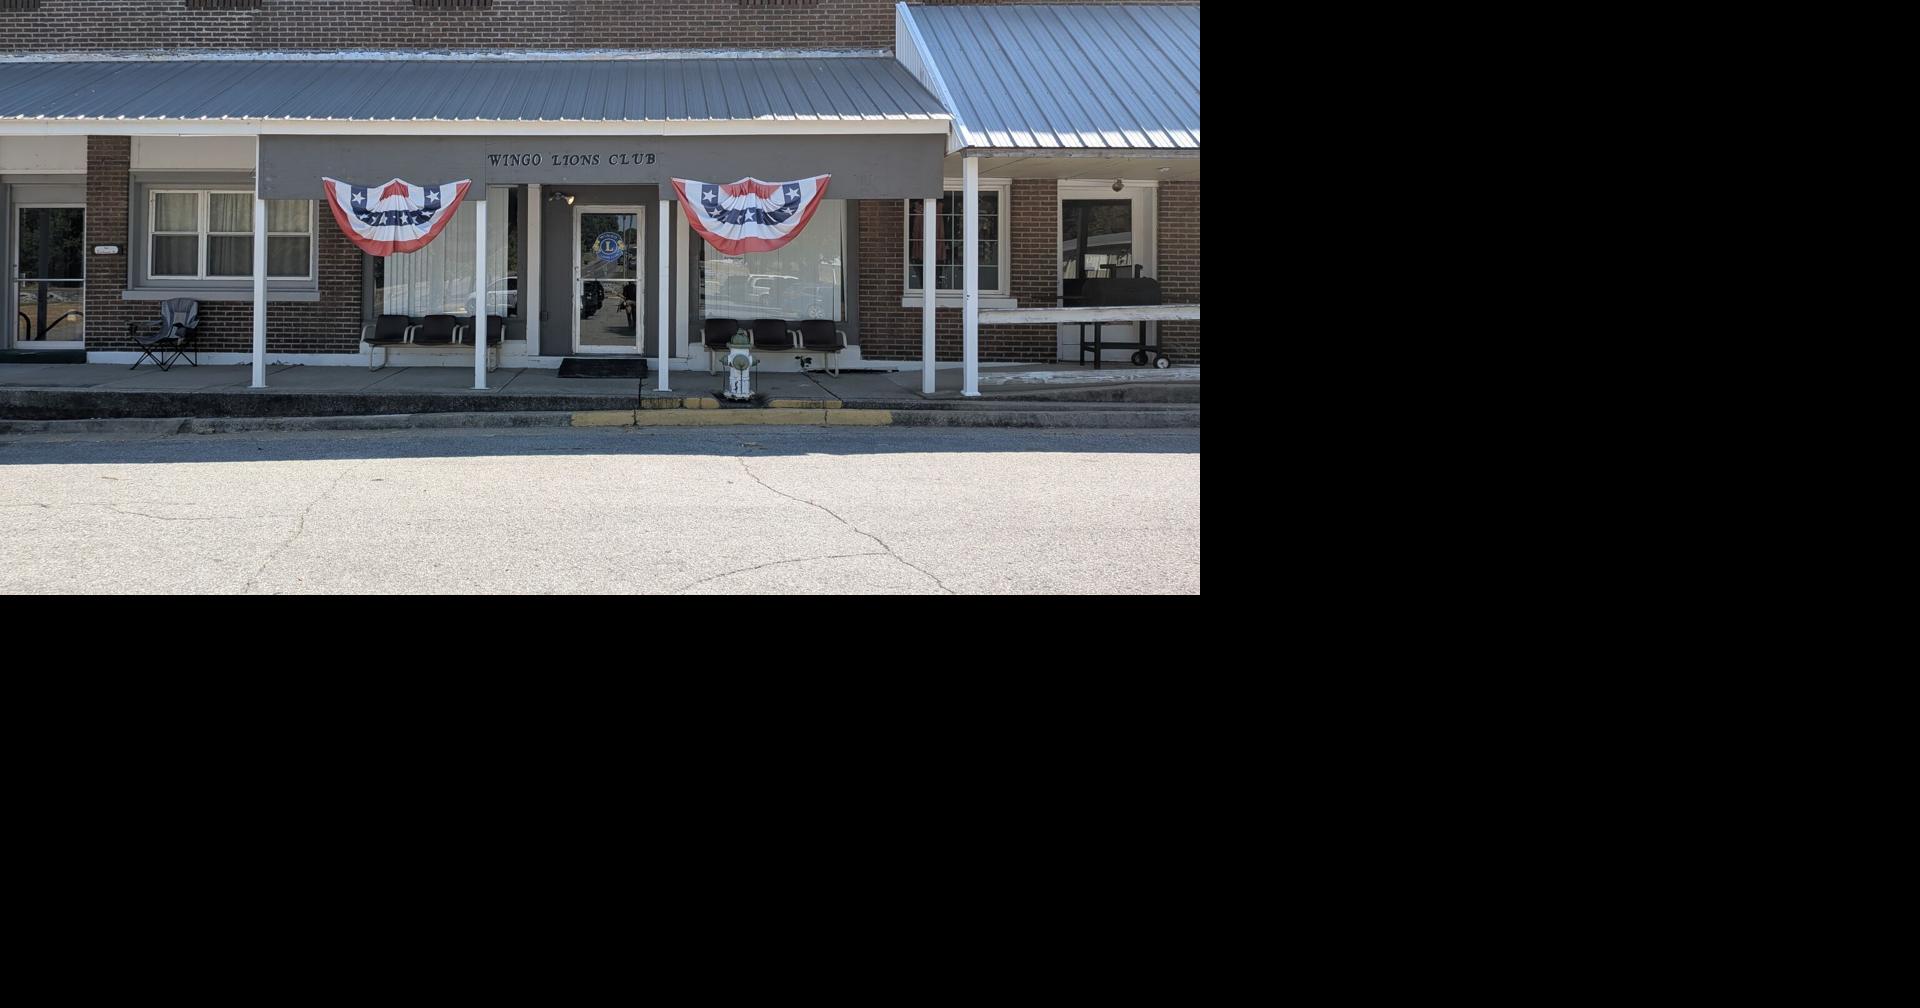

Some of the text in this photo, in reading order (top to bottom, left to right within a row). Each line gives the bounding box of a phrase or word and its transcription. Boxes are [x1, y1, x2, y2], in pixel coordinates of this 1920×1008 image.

[487, 153, 656, 166] WINGO LIONS CLUB
[605, 240, 614, 251] L
